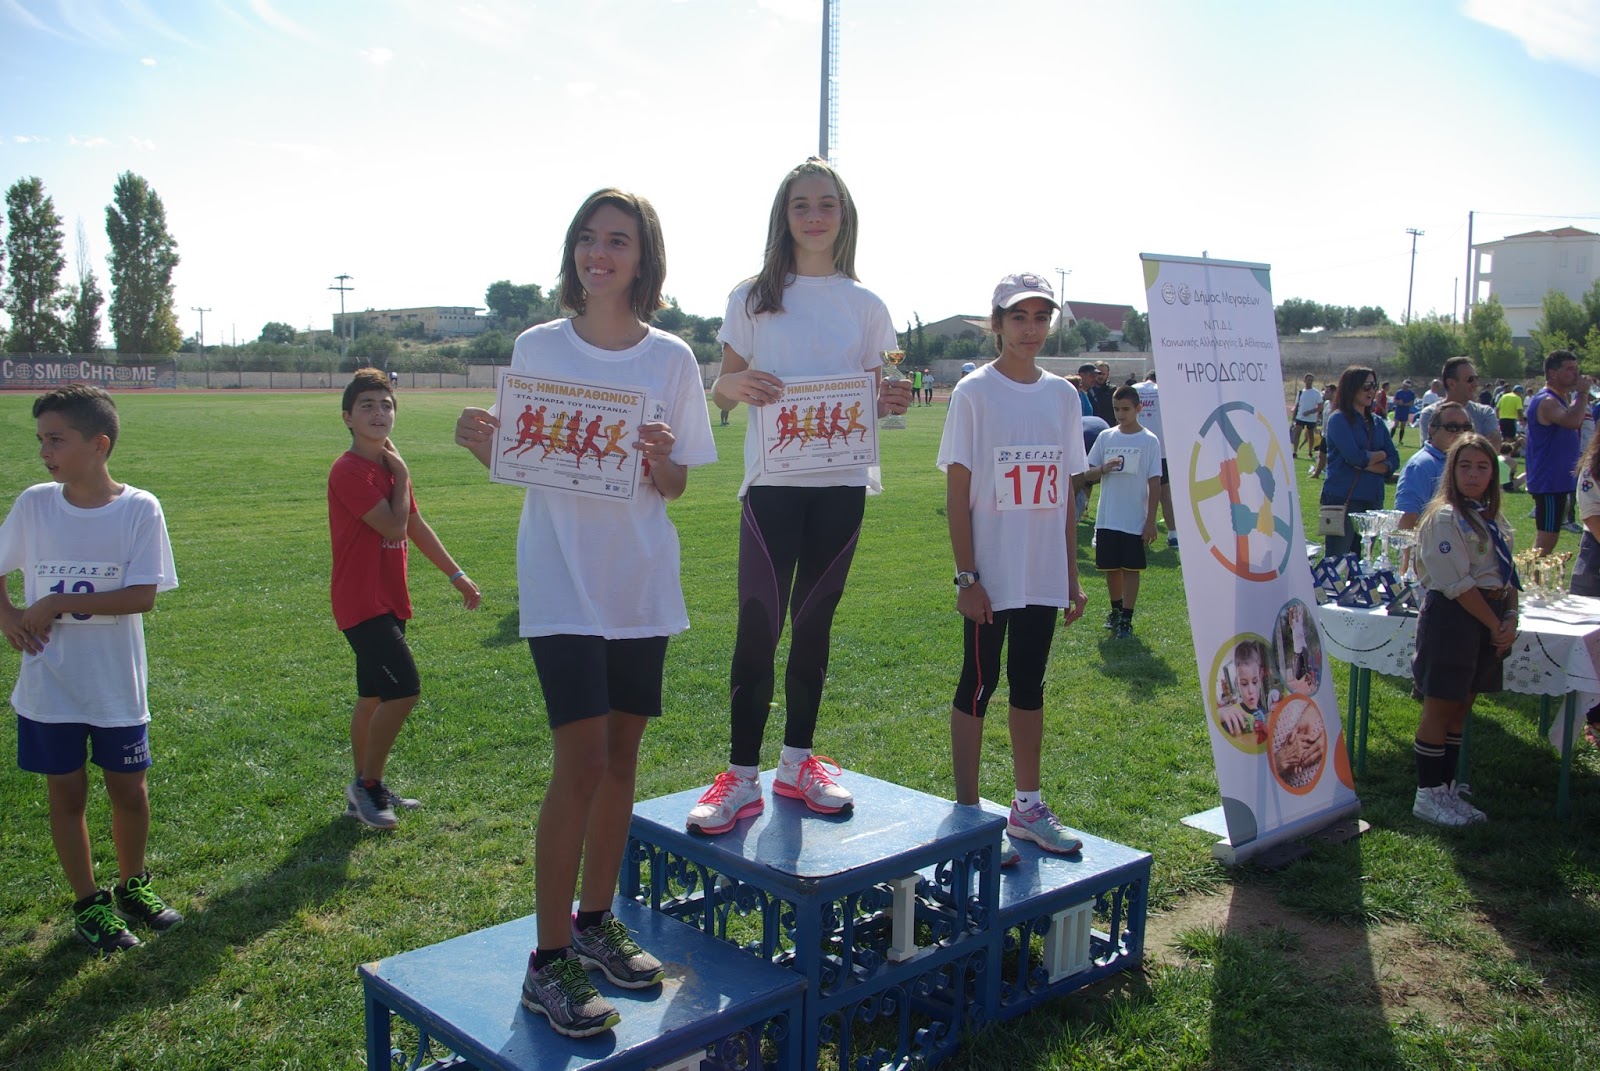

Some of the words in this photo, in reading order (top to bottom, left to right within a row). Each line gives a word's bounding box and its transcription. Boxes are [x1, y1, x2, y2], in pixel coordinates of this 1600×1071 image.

[1194, 289, 1221, 306] Δήμος
[1221, 290, 1260, 307] Μεγαρέων
[507, 378, 534, 394] 15ος
[536, 382, 639, 406] ΗΜΙΜΑΡΑΘΩΝΙΟΣ
[787, 380, 867, 395] ΗΜΙΜΑΡΑΘΩΝΙΟΣ
[1005, 464, 1058, 504] 173
